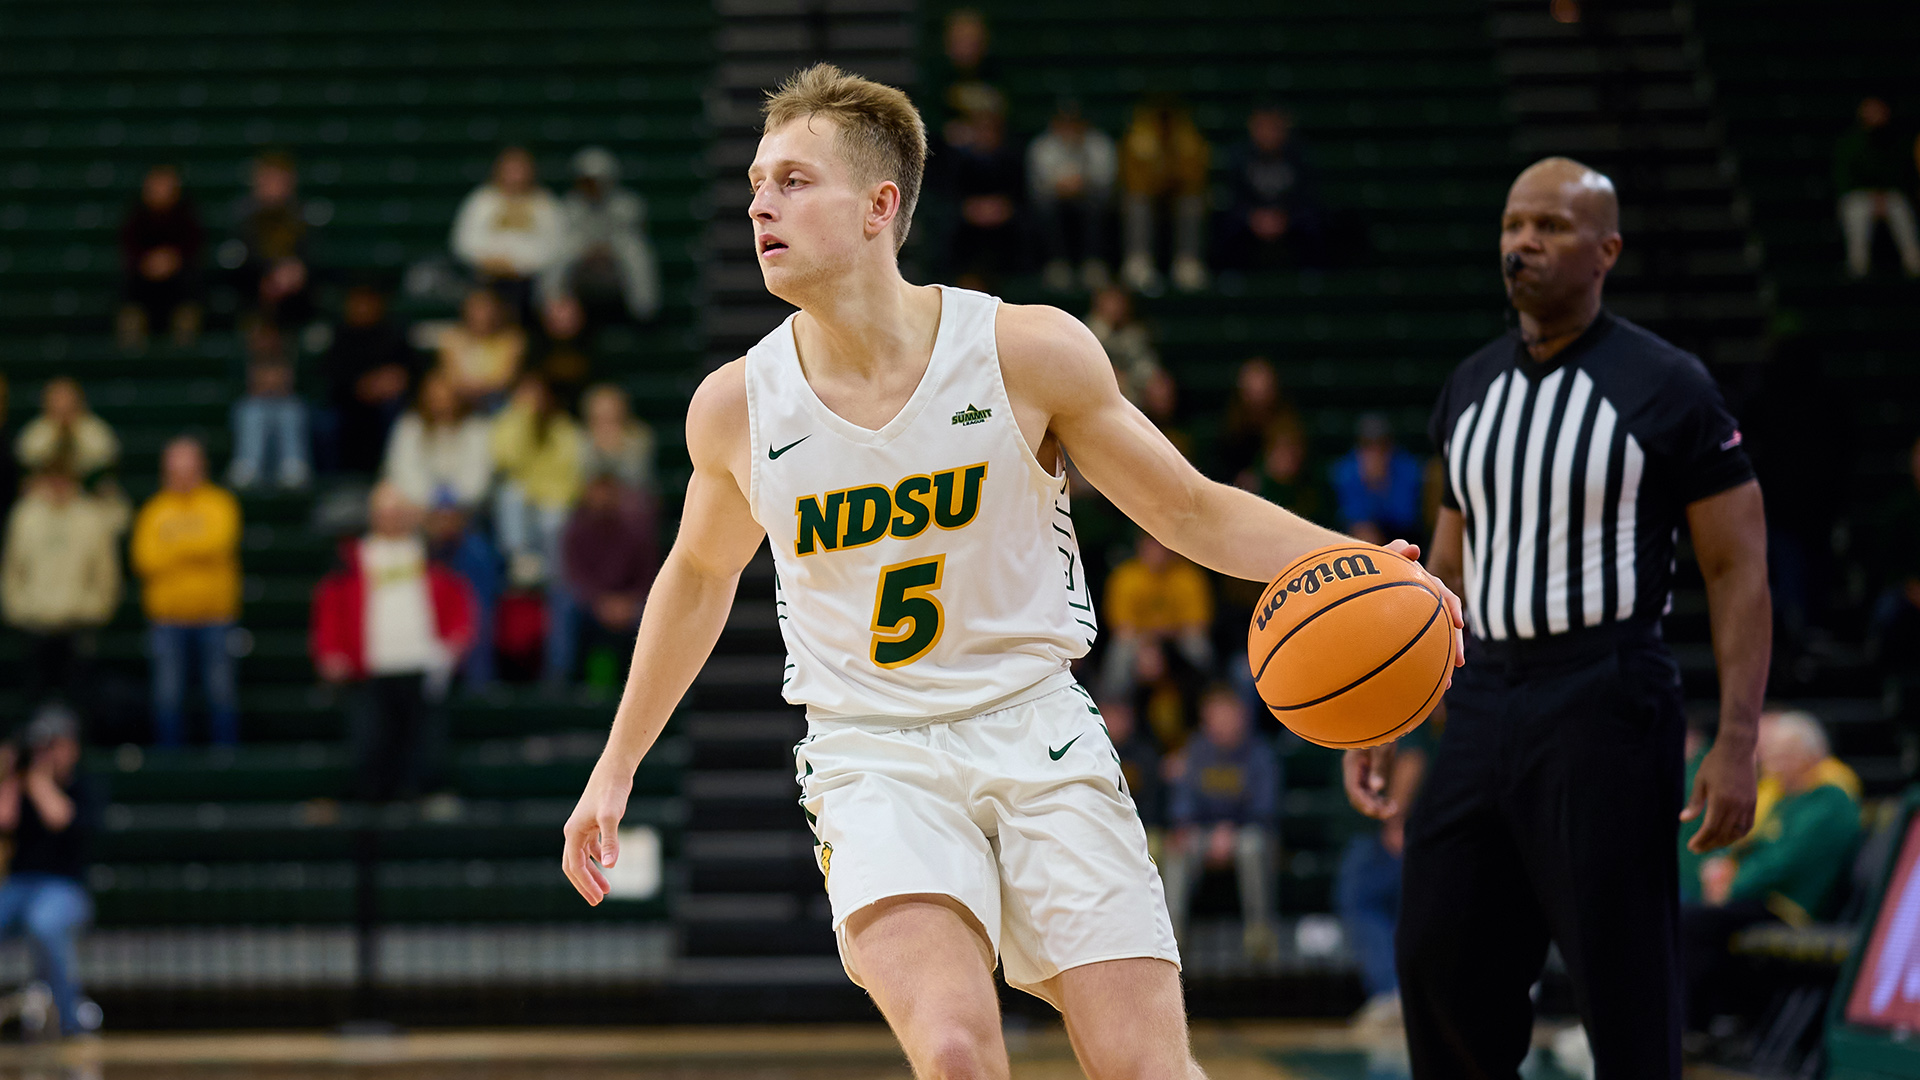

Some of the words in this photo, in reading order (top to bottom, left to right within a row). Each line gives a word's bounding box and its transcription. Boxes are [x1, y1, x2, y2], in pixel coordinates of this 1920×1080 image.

[951, 408, 992, 425] SUMMIT
[794, 461, 989, 558] NDSU
[869, 553, 947, 670] 5
[1256, 554, 1381, 631] Wilson
